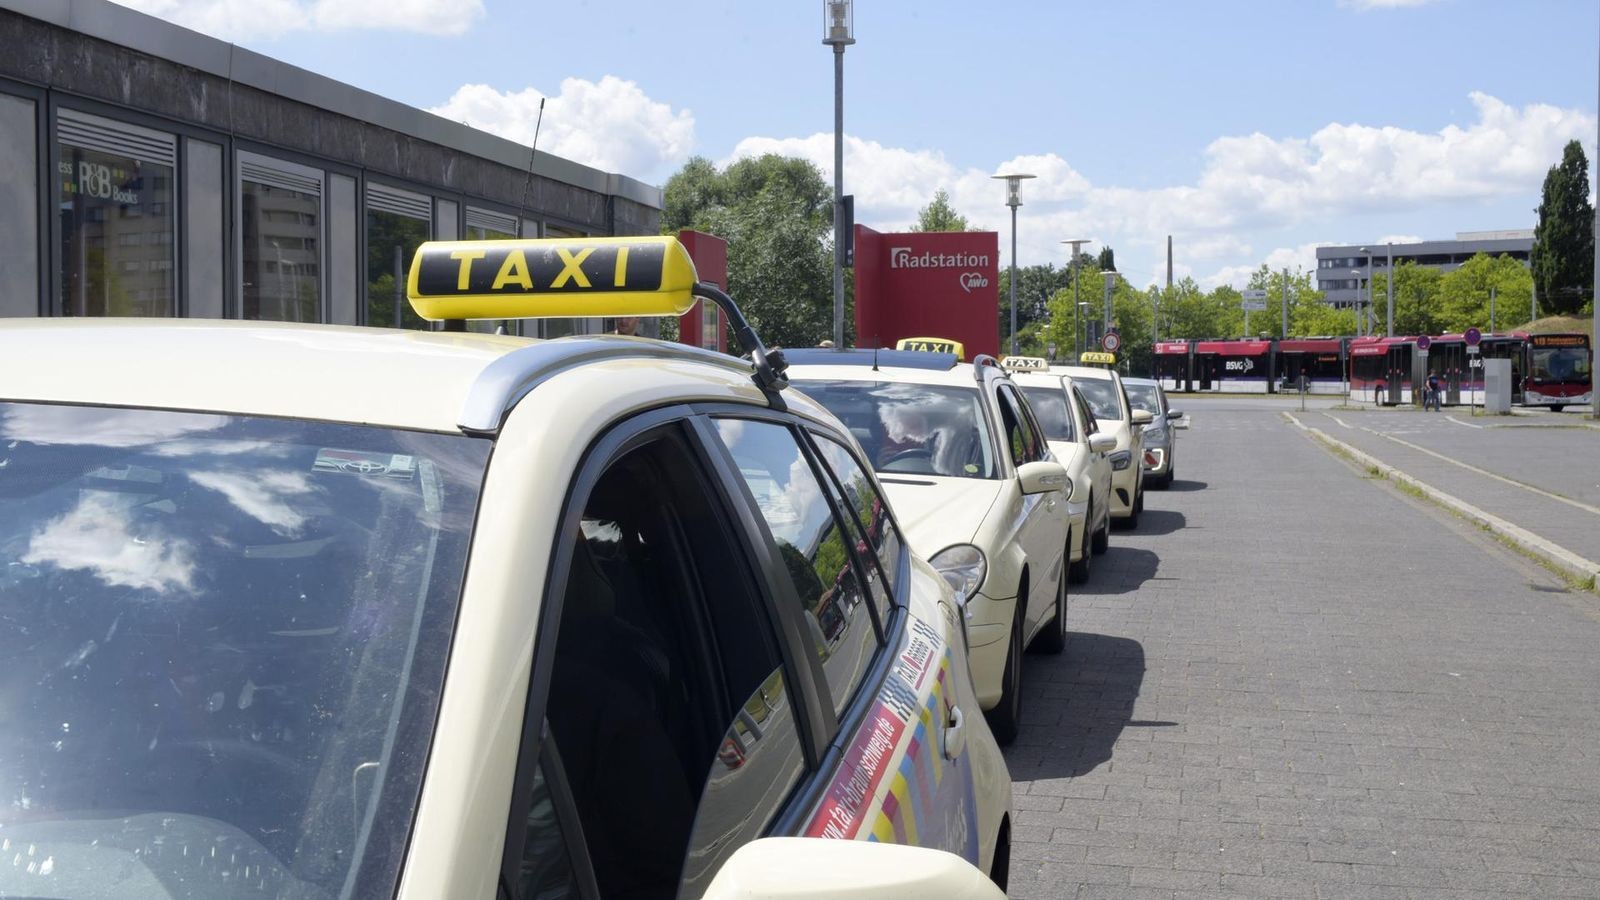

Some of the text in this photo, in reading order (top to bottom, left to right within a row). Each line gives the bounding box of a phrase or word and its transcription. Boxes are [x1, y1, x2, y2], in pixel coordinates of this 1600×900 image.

[58, 162, 72, 174] ess
[113, 185, 138, 204] Books
[898, 251, 989, 268] Radstation
[450, 246, 629, 290] TAXI
[966, 278, 989, 288] AWO
[909, 342, 948, 353] TAXI
[1008, 359, 1042, 368] TAXI
[1087, 354, 1110, 362] TAXI
[1226, 361, 1243, 370] BSVG
[897, 662, 917, 684] TAXI
[821, 717, 895, 839] w.taxi-braunschweig.de
